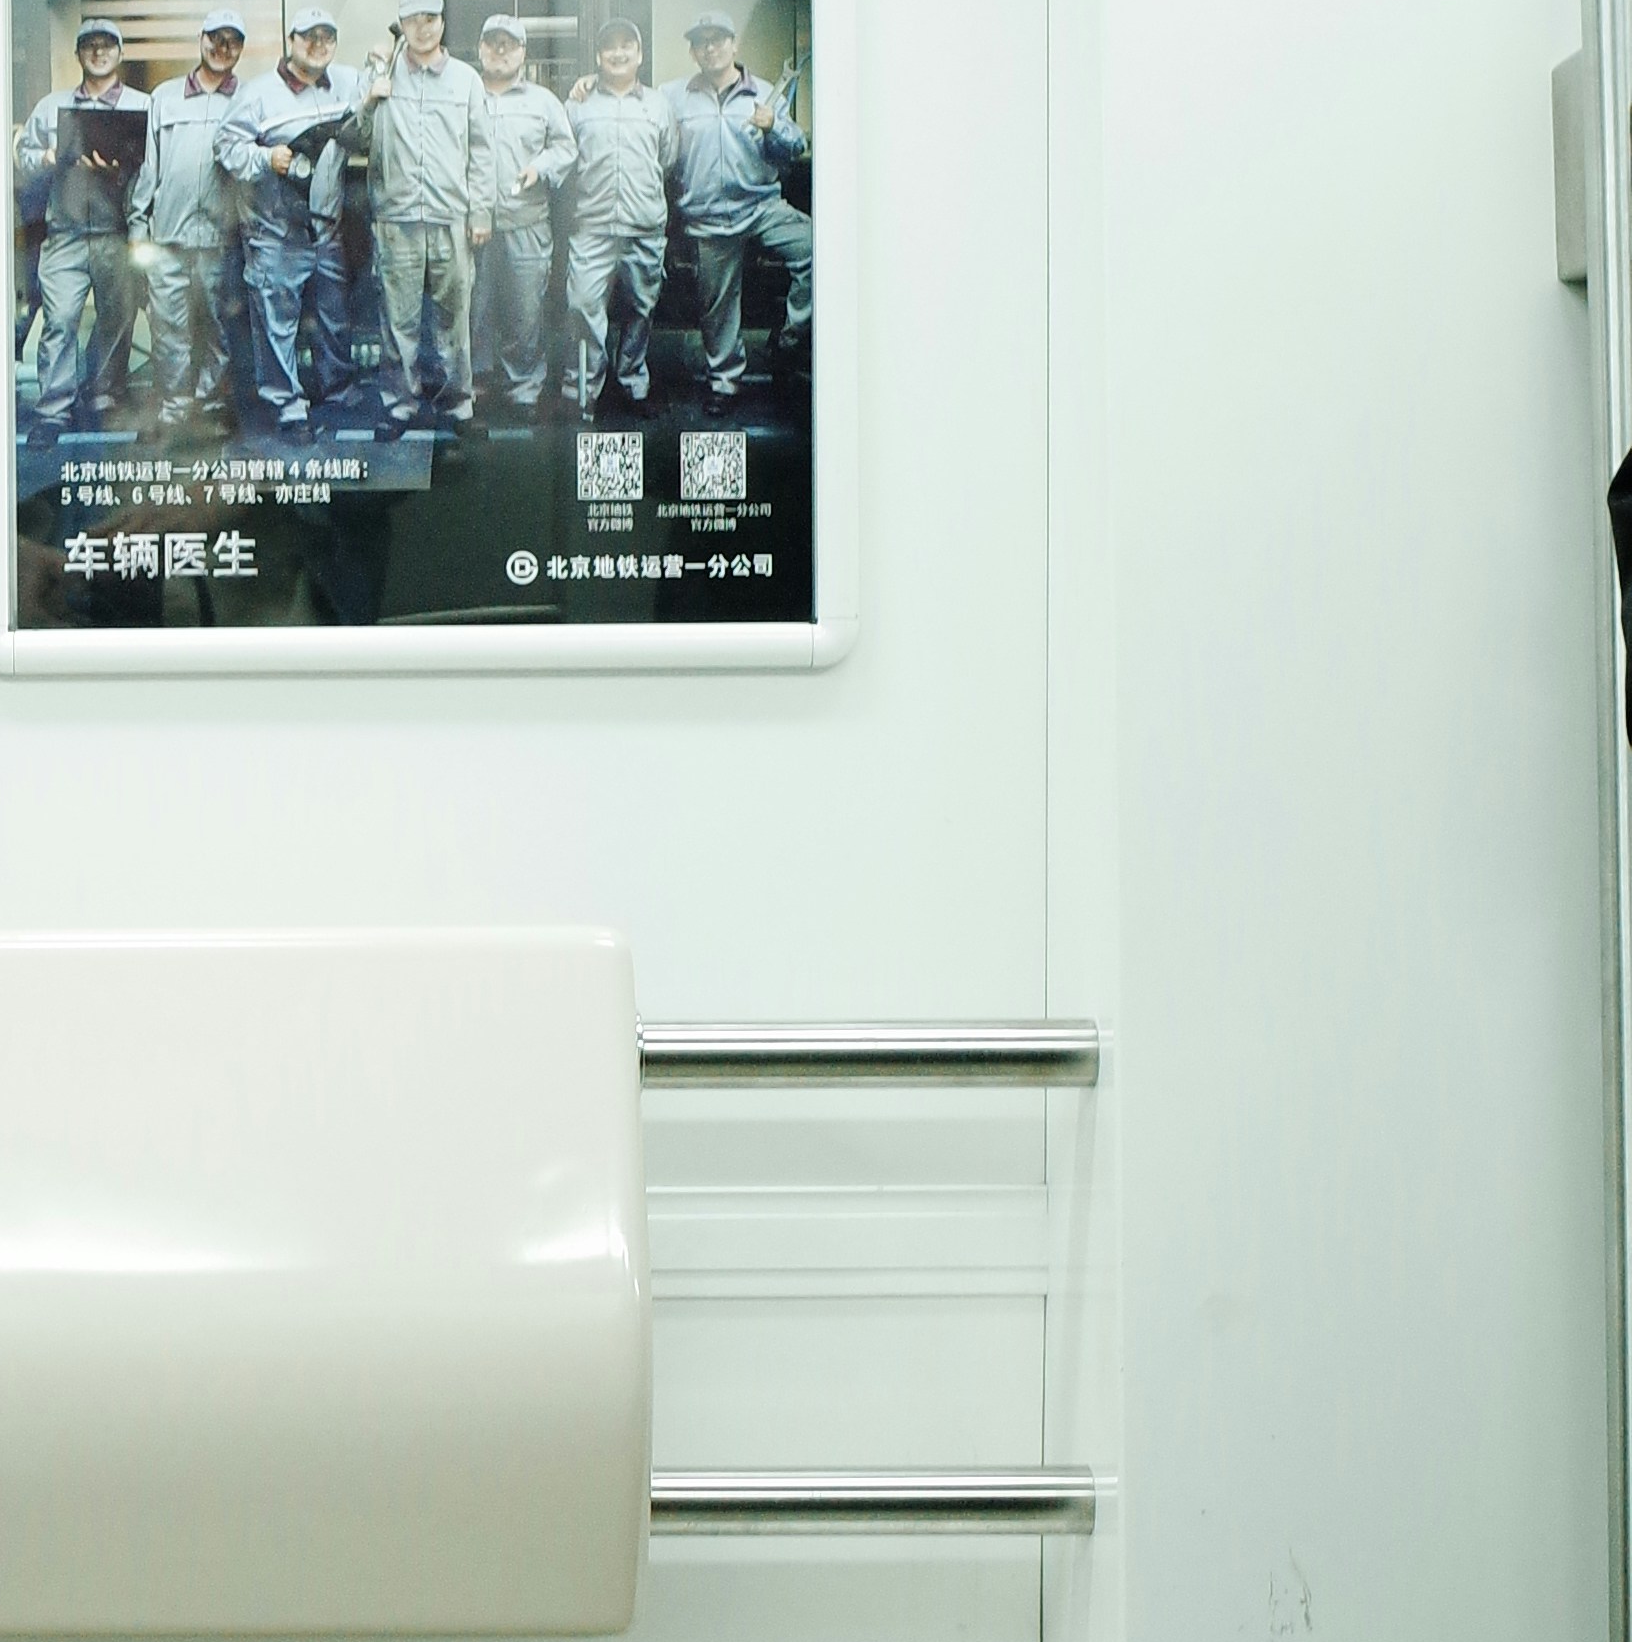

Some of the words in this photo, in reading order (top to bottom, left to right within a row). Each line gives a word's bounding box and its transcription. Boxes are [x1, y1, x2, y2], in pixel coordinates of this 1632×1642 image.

[63, 529, 259, 581] 车辆医生
[546, 553, 774, 580] 北京地铁运营一分公司
